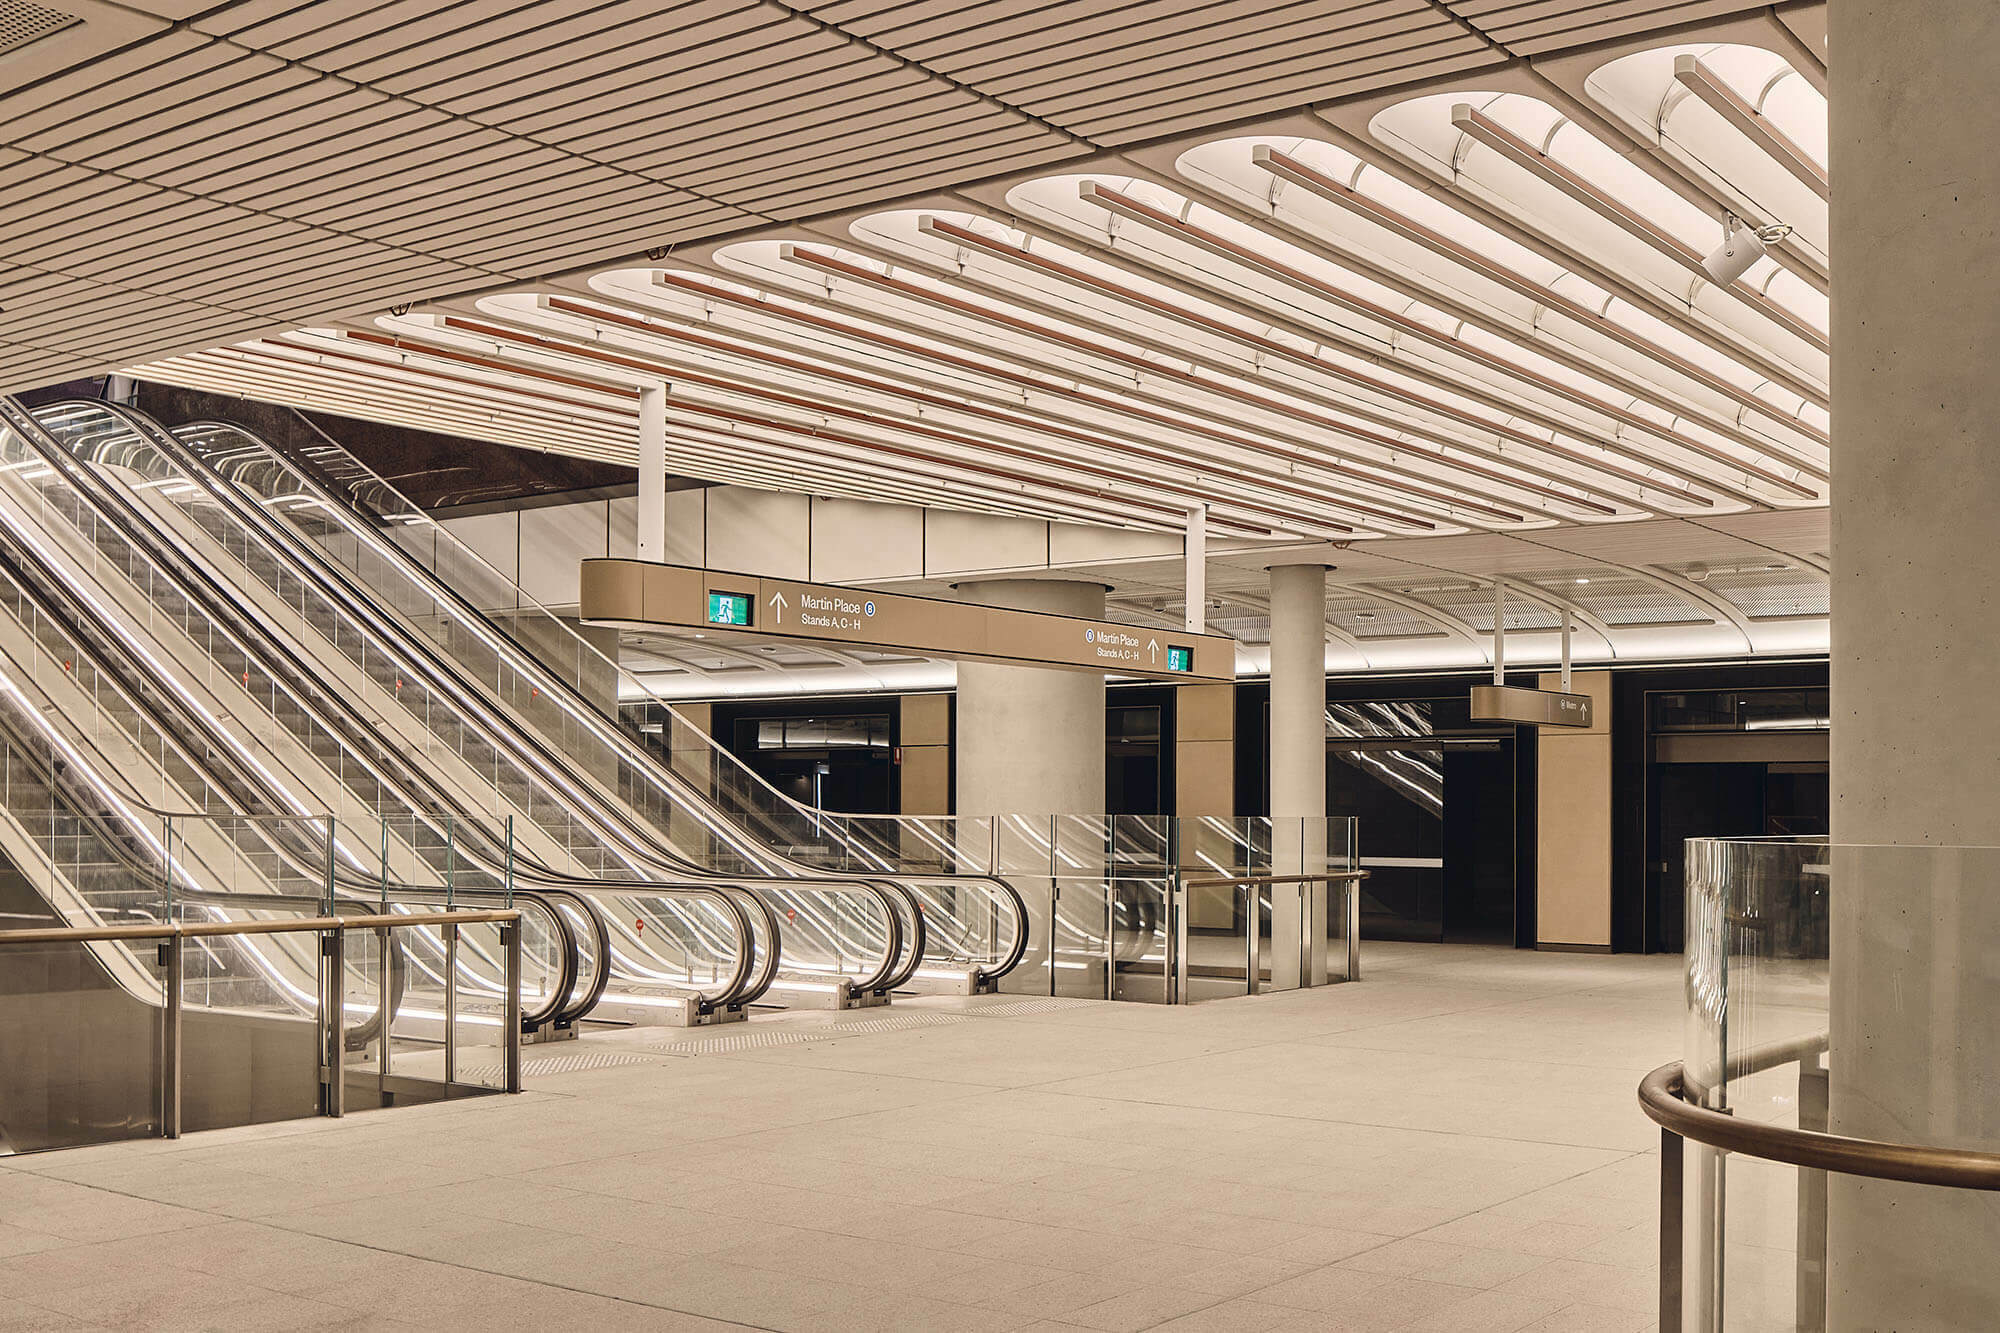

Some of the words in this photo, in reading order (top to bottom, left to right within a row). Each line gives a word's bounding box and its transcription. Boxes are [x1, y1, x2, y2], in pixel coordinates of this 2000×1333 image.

[801, 594, 832, 611] Martin
[834, 598, 861, 614] Place
[801, 613, 830, 627] Stands
[1096, 631, 1119, 645] Martin
[1120, 633, 1139, 647] Place
[1097, 646, 1117, 658] Stands
